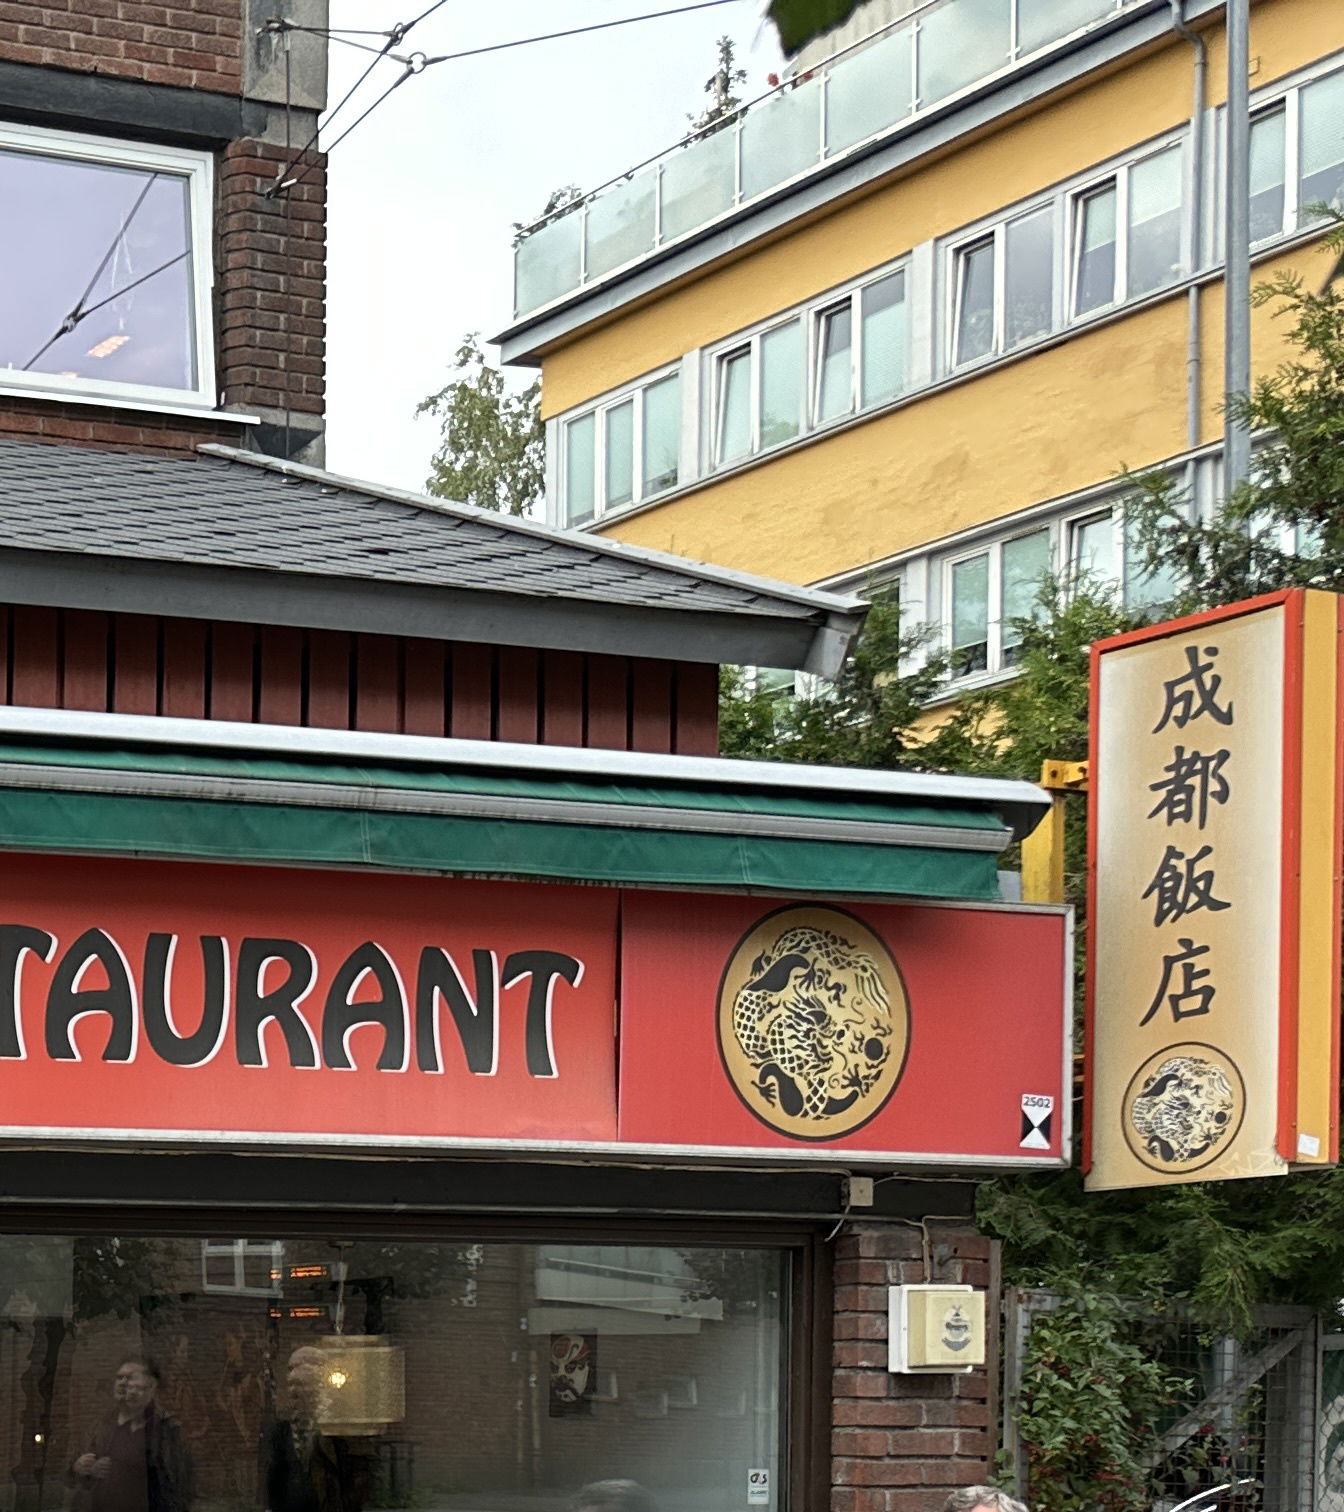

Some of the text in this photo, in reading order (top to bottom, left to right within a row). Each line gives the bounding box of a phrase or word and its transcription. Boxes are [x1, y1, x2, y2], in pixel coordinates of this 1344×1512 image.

[1139, 645, 1234, 1028] 成都飯店
[1023, 1096, 1051, 1109] 2502
